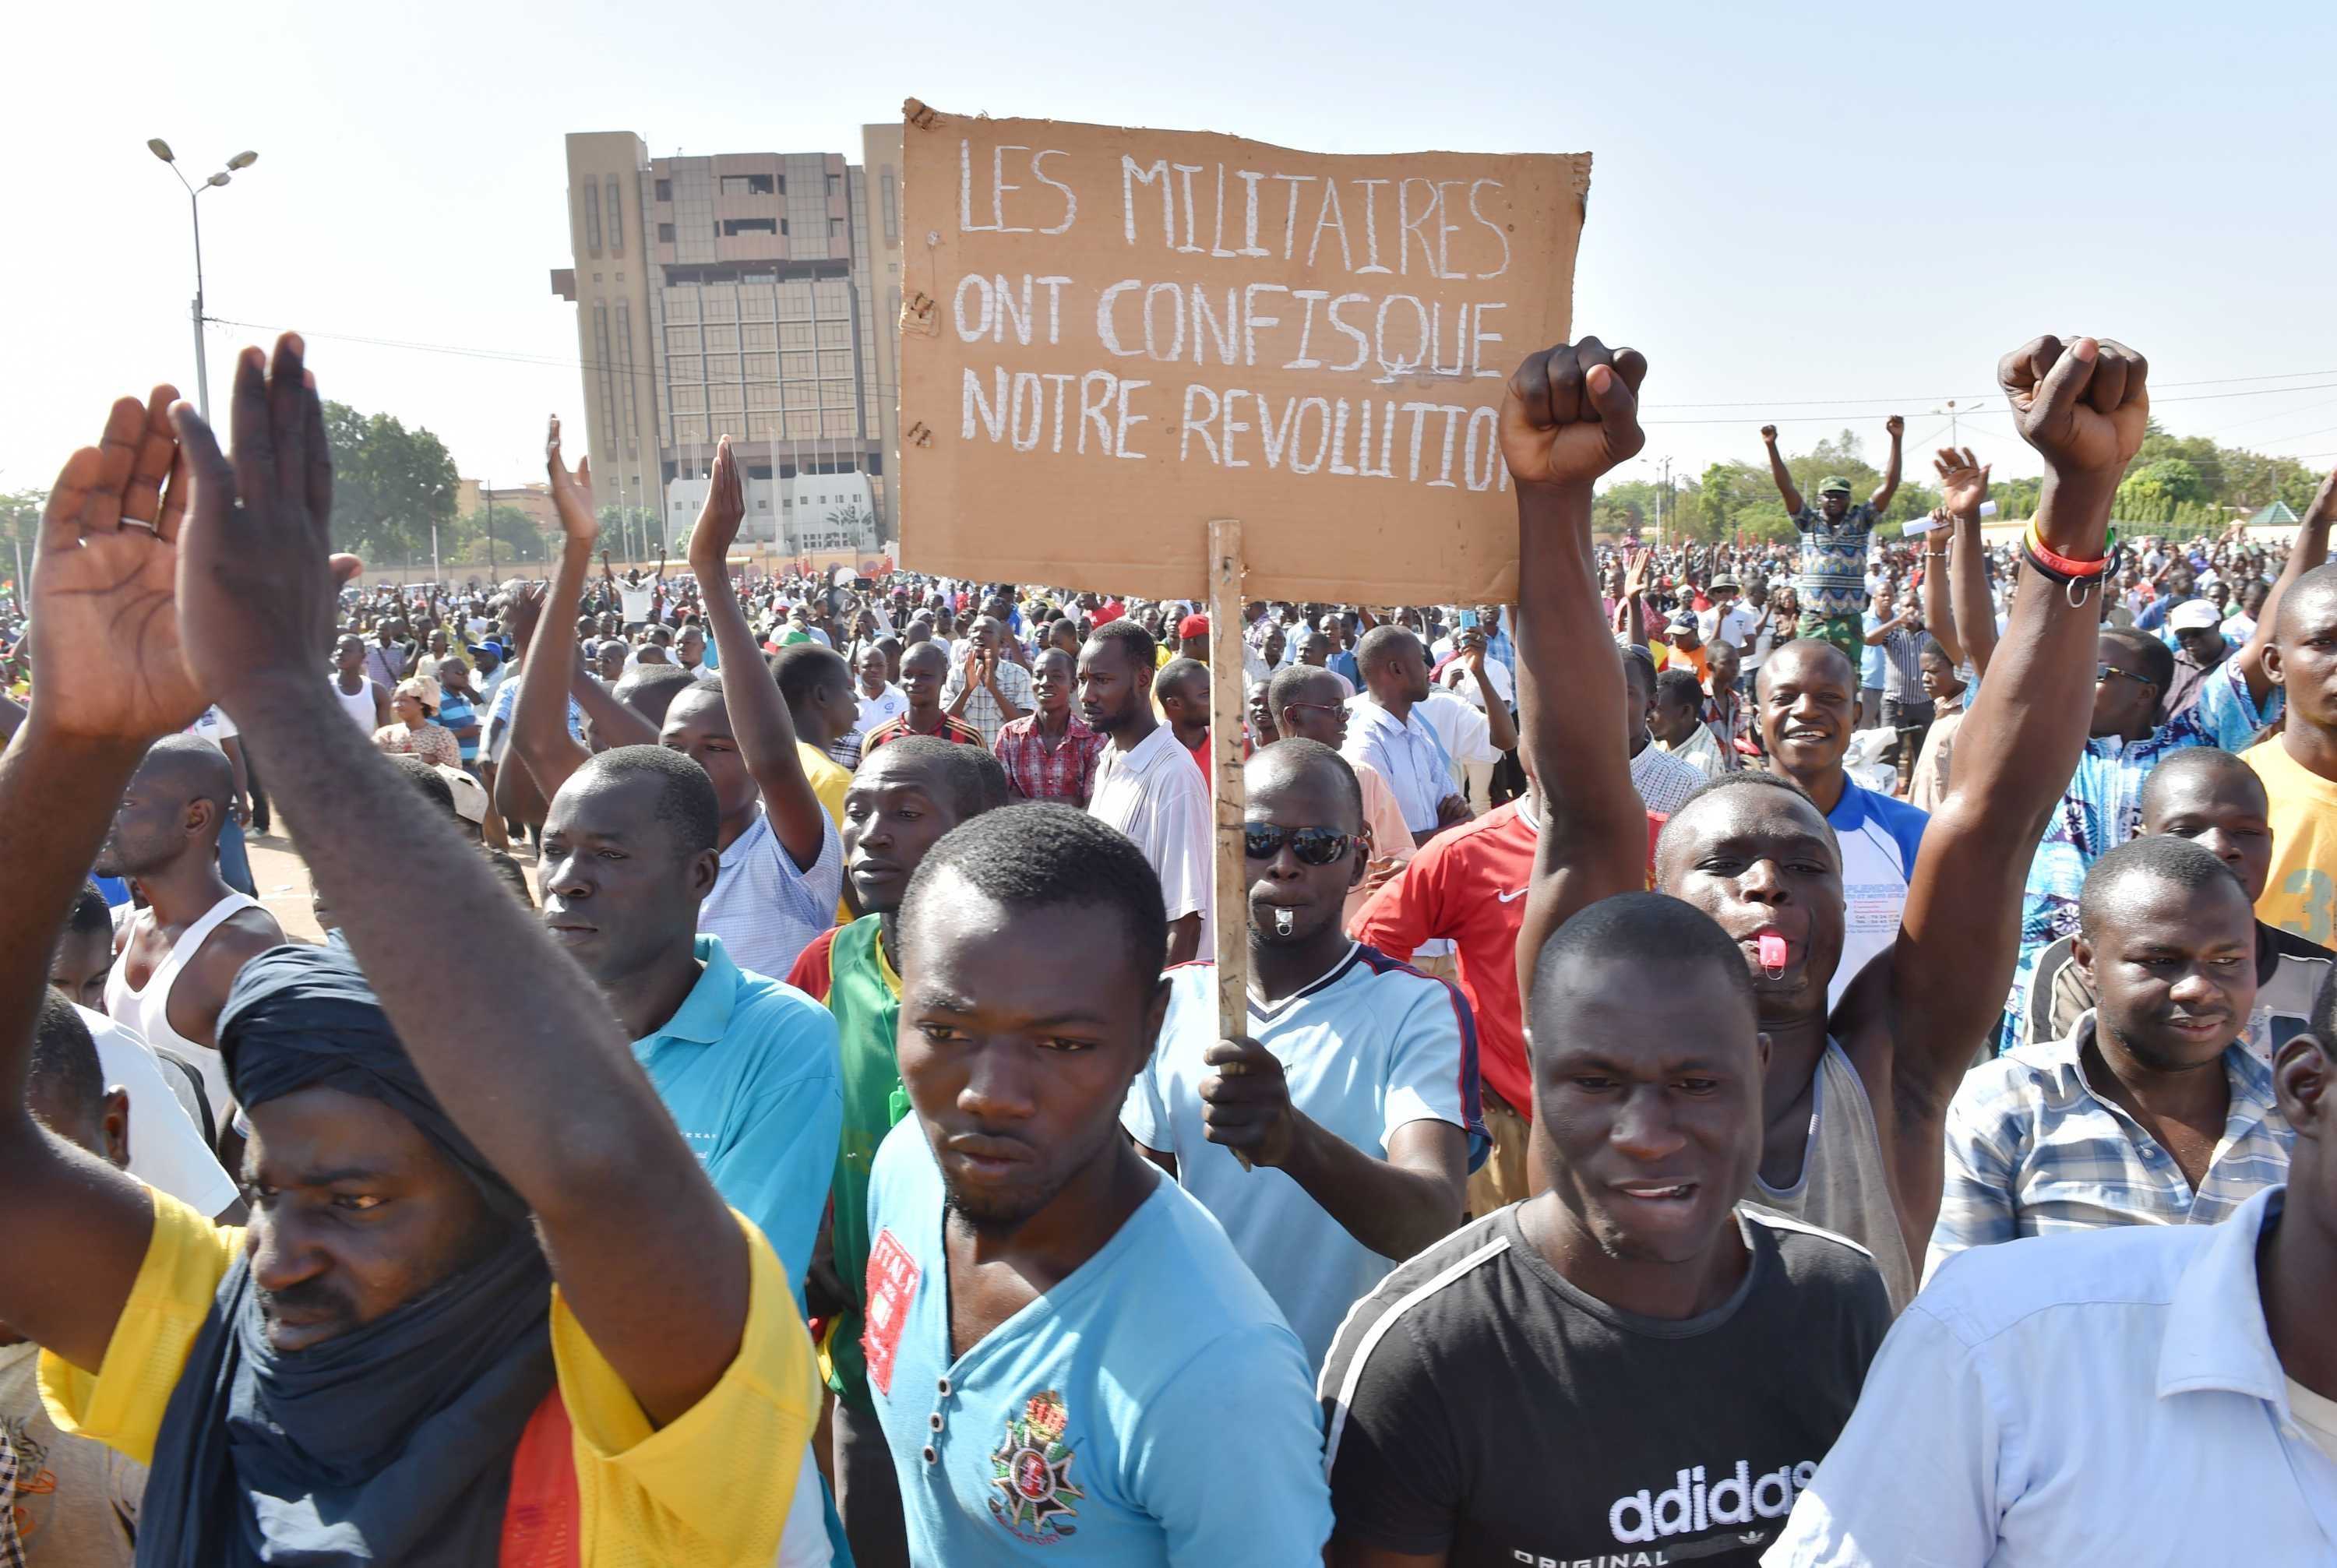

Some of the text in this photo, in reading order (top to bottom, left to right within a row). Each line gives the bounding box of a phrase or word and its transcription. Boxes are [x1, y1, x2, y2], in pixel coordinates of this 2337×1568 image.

[961, 139, 1510, 280] LES MILITAIRES
[953, 273, 1507, 384] ONT CONFISQUE
[961, 365, 1151, 460] NOTRE
[876, 1240, 918, 1295] ITALY
